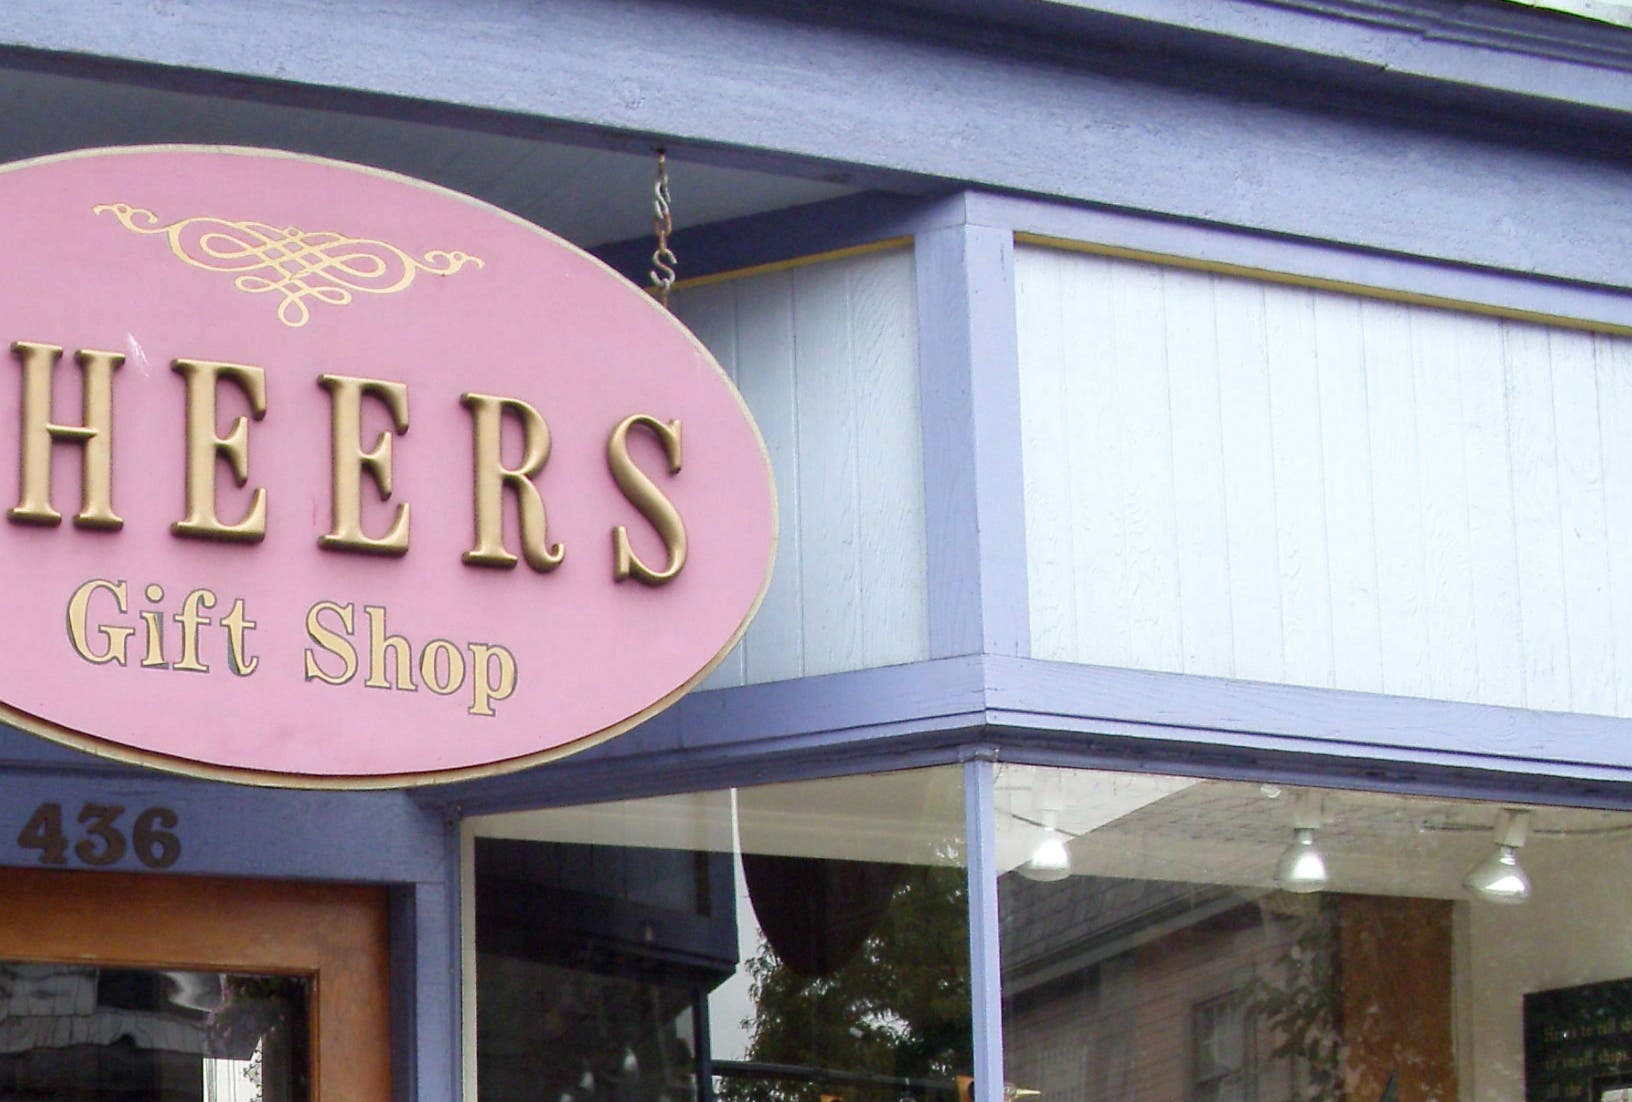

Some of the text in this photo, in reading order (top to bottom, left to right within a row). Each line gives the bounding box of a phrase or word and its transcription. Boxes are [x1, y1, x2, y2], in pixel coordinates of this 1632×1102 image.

[66, 578, 518, 716] Gift Shop
[16, 802, 182, 868] 436
